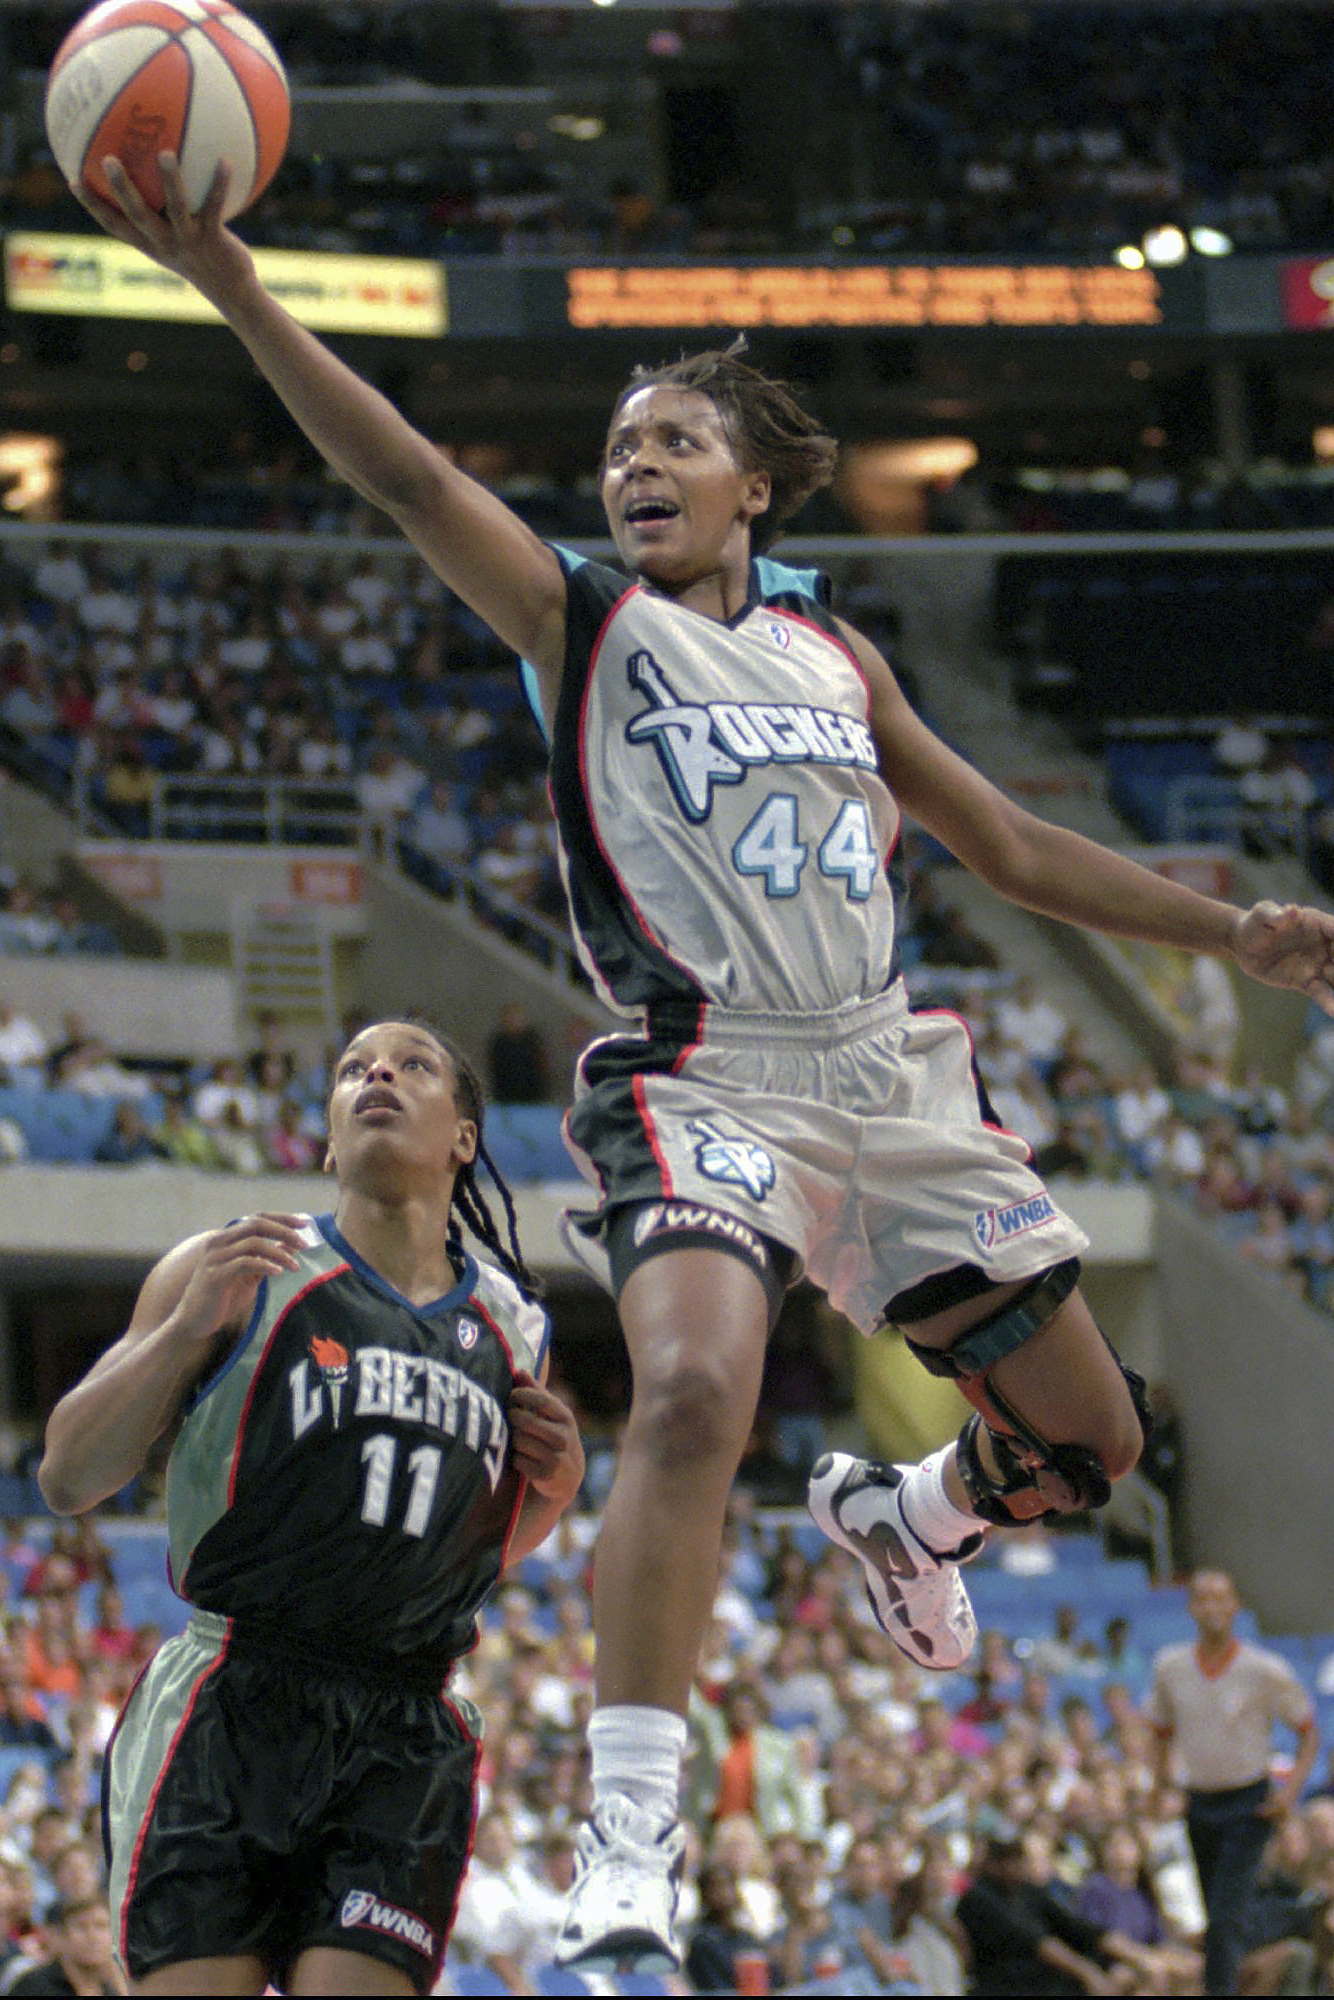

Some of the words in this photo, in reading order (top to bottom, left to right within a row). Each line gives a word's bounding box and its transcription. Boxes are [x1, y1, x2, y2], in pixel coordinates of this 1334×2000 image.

[732, 793, 878, 902] 44
[997, 1195, 1055, 1234] WNBA
[289, 1334, 509, 1496] LIBERTY
[360, 1433, 442, 1539] 11
[370, 1904, 433, 1956] WNBA
